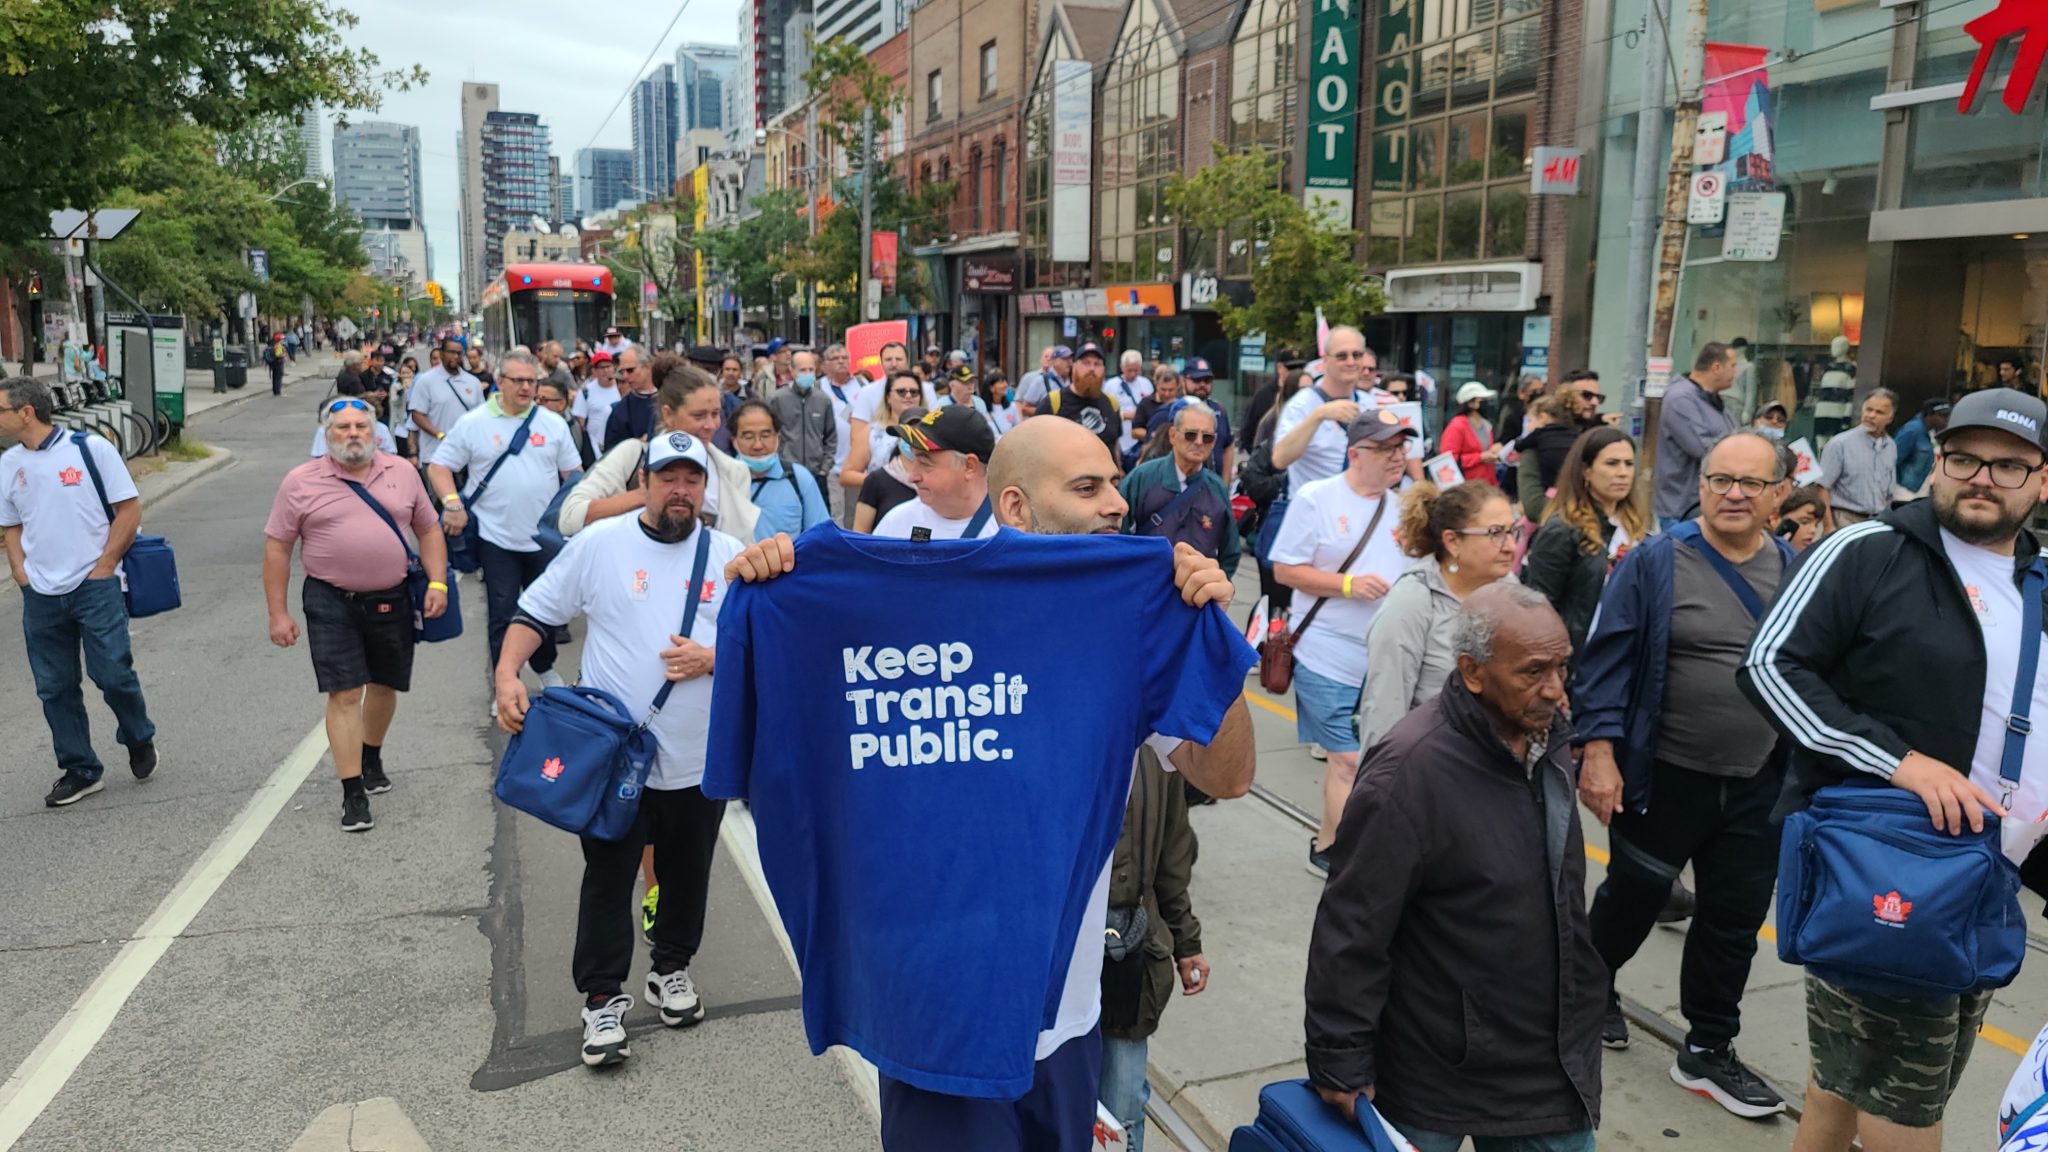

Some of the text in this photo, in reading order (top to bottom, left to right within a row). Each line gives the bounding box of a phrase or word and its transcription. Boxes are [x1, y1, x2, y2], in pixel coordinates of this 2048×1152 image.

[1191, 277, 1218, 304] 423
[1996, 409, 2037, 432] RONA
[843, 642, 973, 683] Keep
[846, 672, 1028, 725] Transit
[850, 719, 1013, 770] Public.
